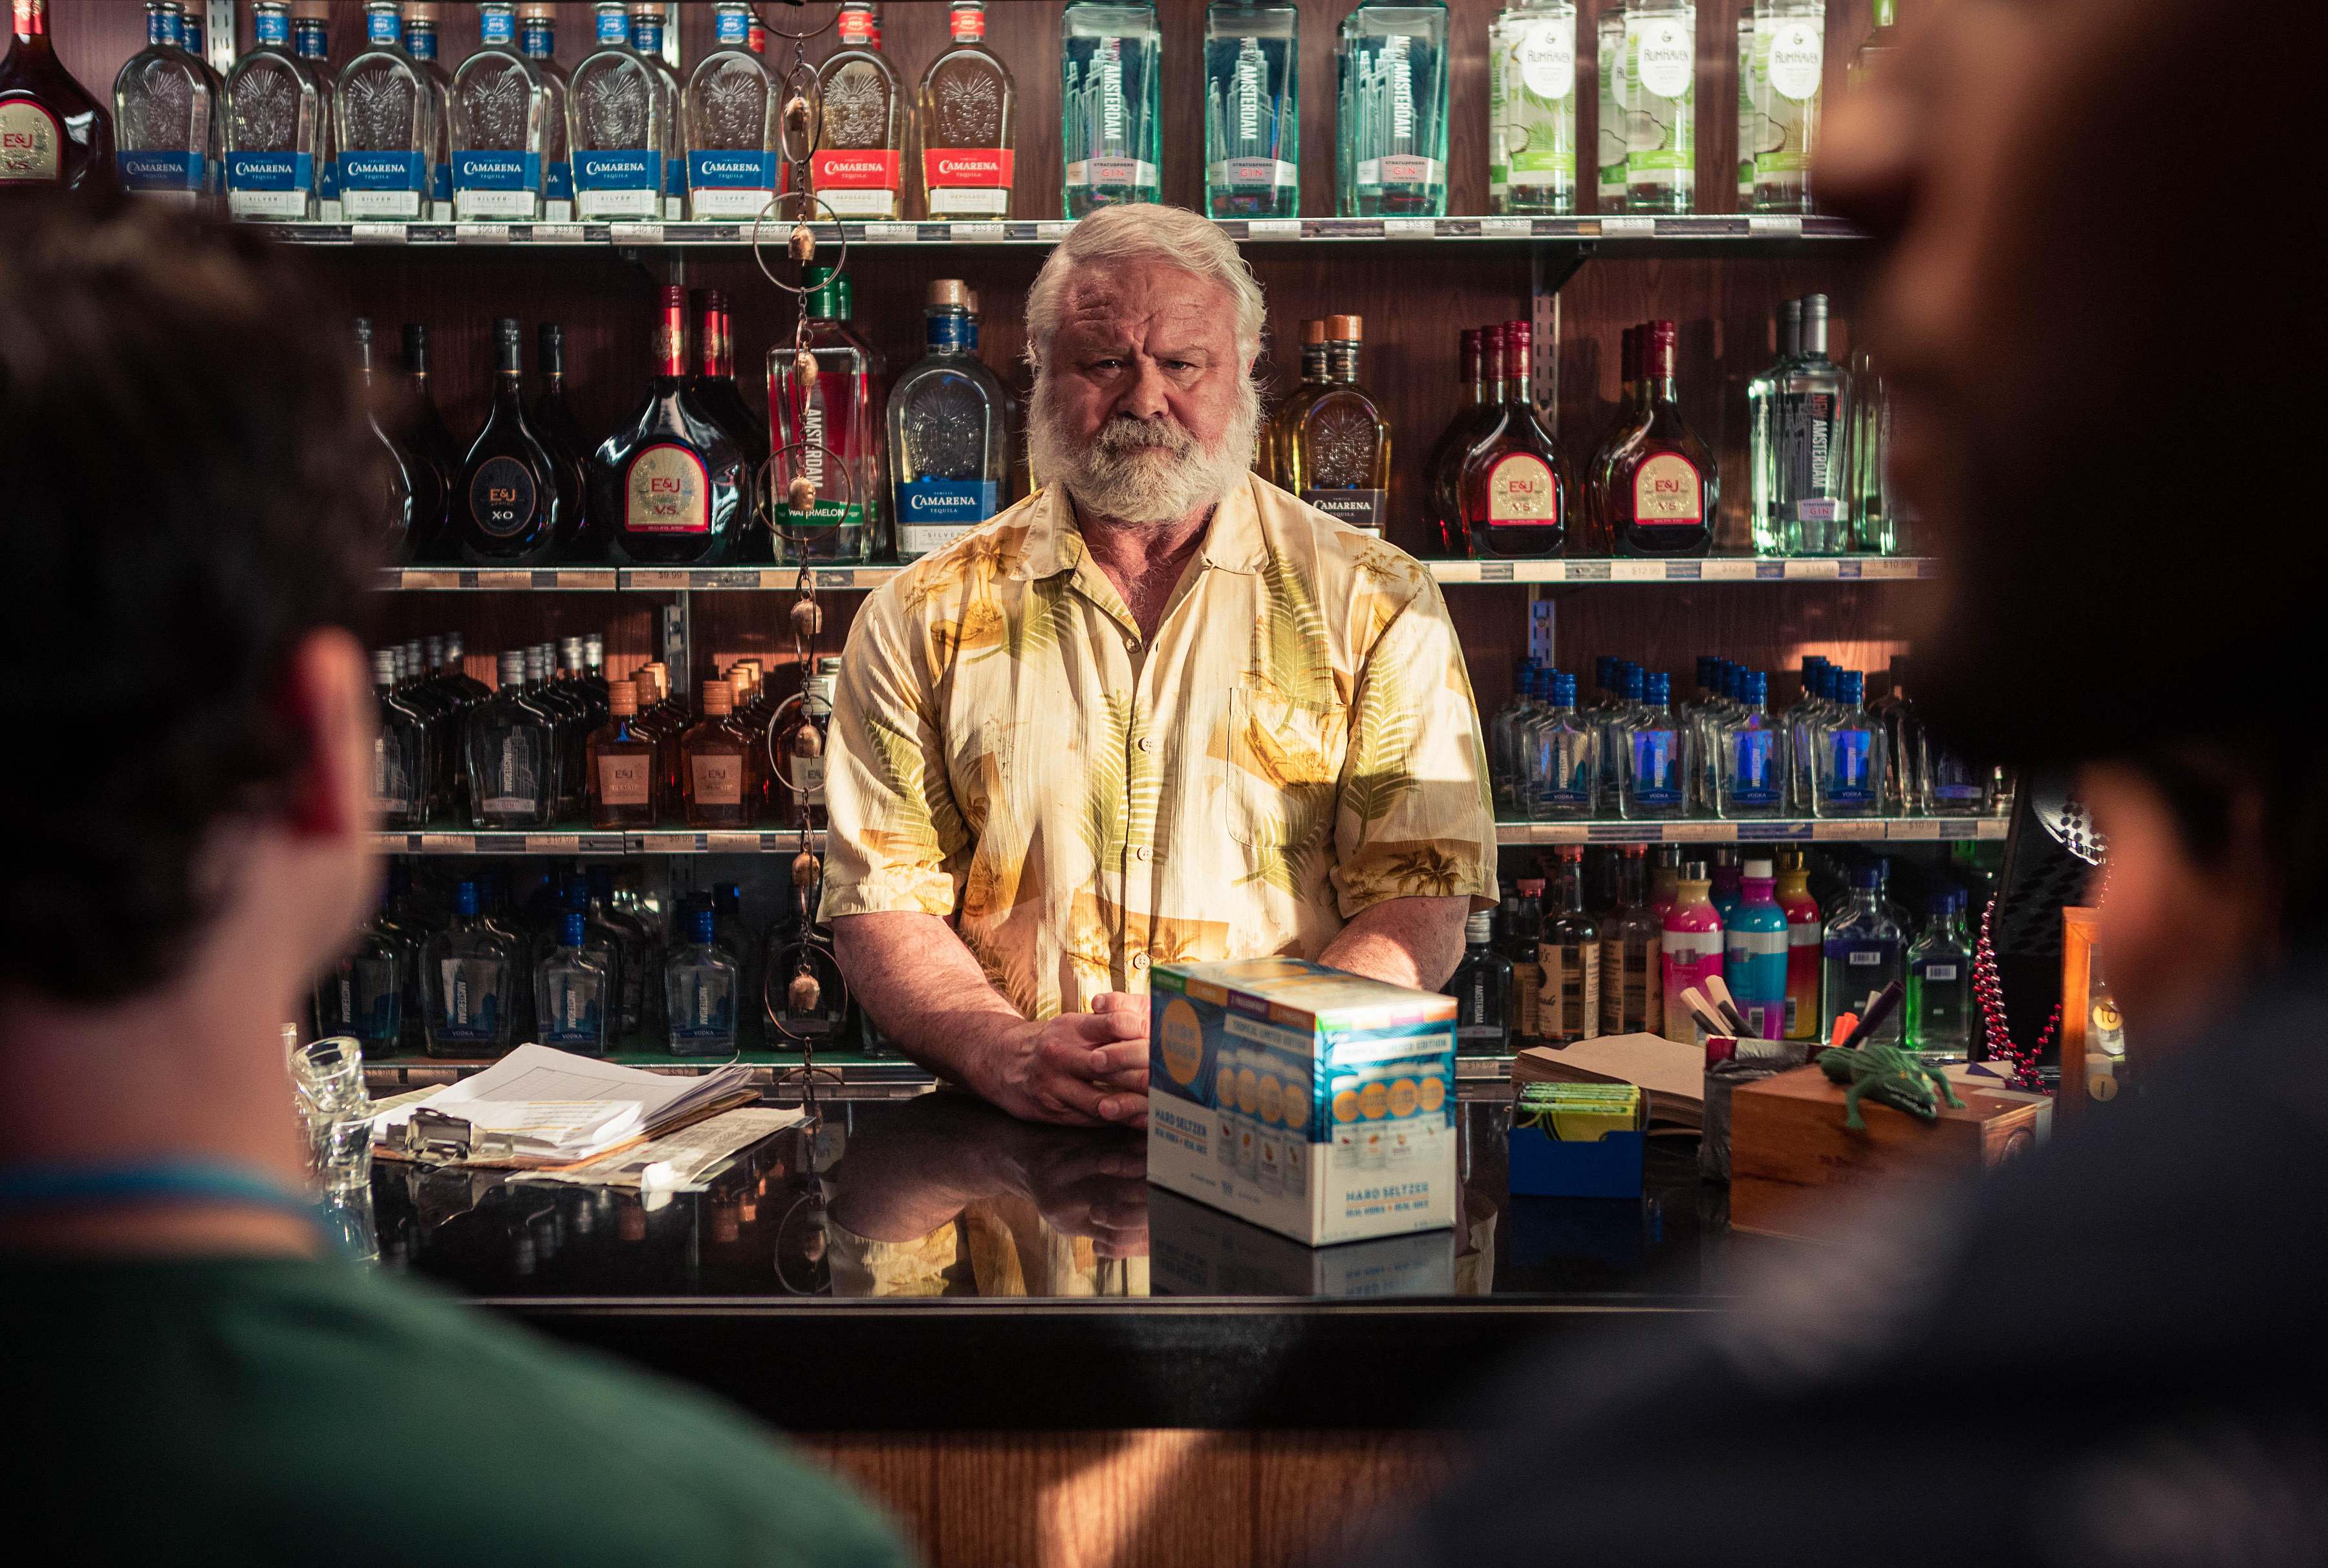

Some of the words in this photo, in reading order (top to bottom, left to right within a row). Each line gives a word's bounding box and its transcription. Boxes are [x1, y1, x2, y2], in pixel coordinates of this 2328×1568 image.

[1104, 65, 1121, 138] AMSTERDAM
[1241, 65, 1257, 139] AMSTERDAM
[1394, 63, 1411, 137] AMSTERDAM
[4, 133, 32, 147] E&J
[127, 162, 184, 175] CAMARENA
[235, 162, 292, 175] CAMARENA
[348, 162, 405, 175] CAMARENA
[464, 162, 521, 175] CAMARENA
[586, 162, 645, 175] CAMARENA
[702, 161, 760, 175] CAMARENA
[824, 161, 883, 175] CAMARENA
[939, 160, 998, 173] CAMARENA
[1102, 168, 1124, 177] GIN
[1240, 168, 1262, 177] GIN
[1394, 166, 1416, 175] GIN
[1812, 419, 1827, 488] AMSTERDAM
[651, 477, 680, 493] E&J
[1509, 480, 1533, 493] E&J
[1655, 479, 1679, 493] E&J
[489, 489, 516, 502] E&J
[911, 495, 976, 510] CAMARENA
[1313, 500, 1371, 513] CAMARENA
[1810, 506, 1829, 515] GIN
[1474, 985, 1483, 1023] AMSTERDAM
[1176, 1115, 1207, 1137] SELTZER
[1346, 1188, 1381, 1201] HARD
[1383, 1181, 1428, 1197] SELTZER
